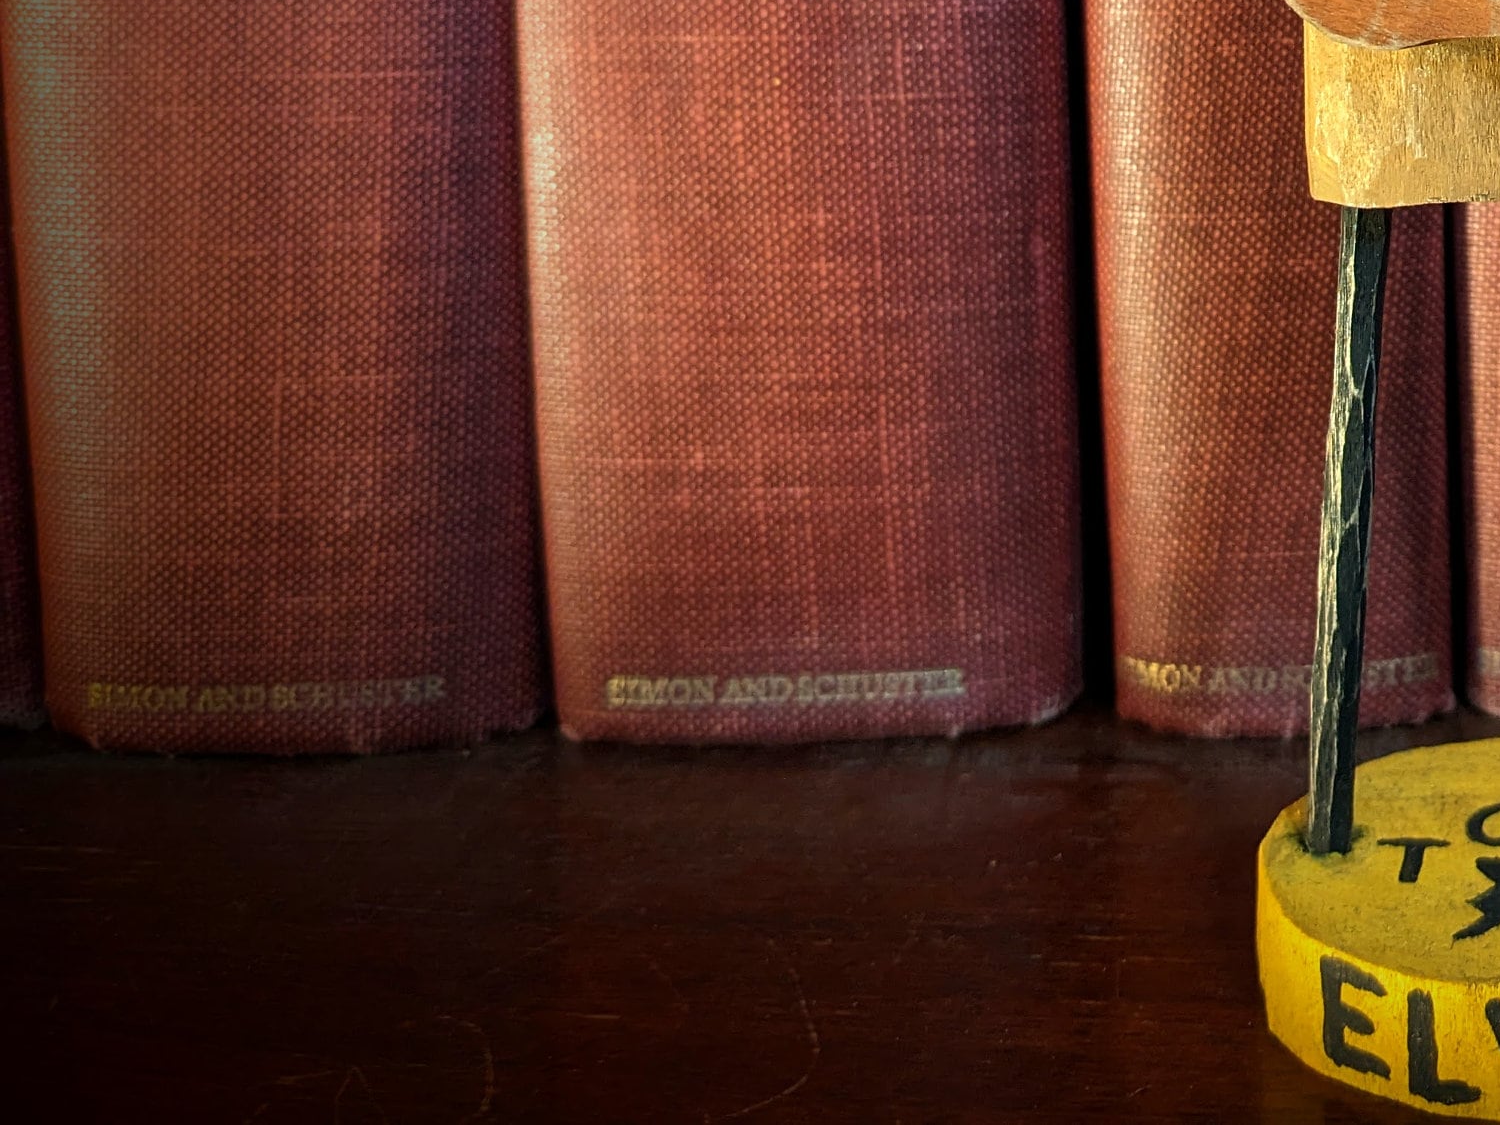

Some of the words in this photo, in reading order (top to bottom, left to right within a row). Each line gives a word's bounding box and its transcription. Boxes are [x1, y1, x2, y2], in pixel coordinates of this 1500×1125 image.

[607, 675, 718, 708] SIMON
[719, 676, 794, 706] AND
[797, 669, 966, 701] SCHUSTER
